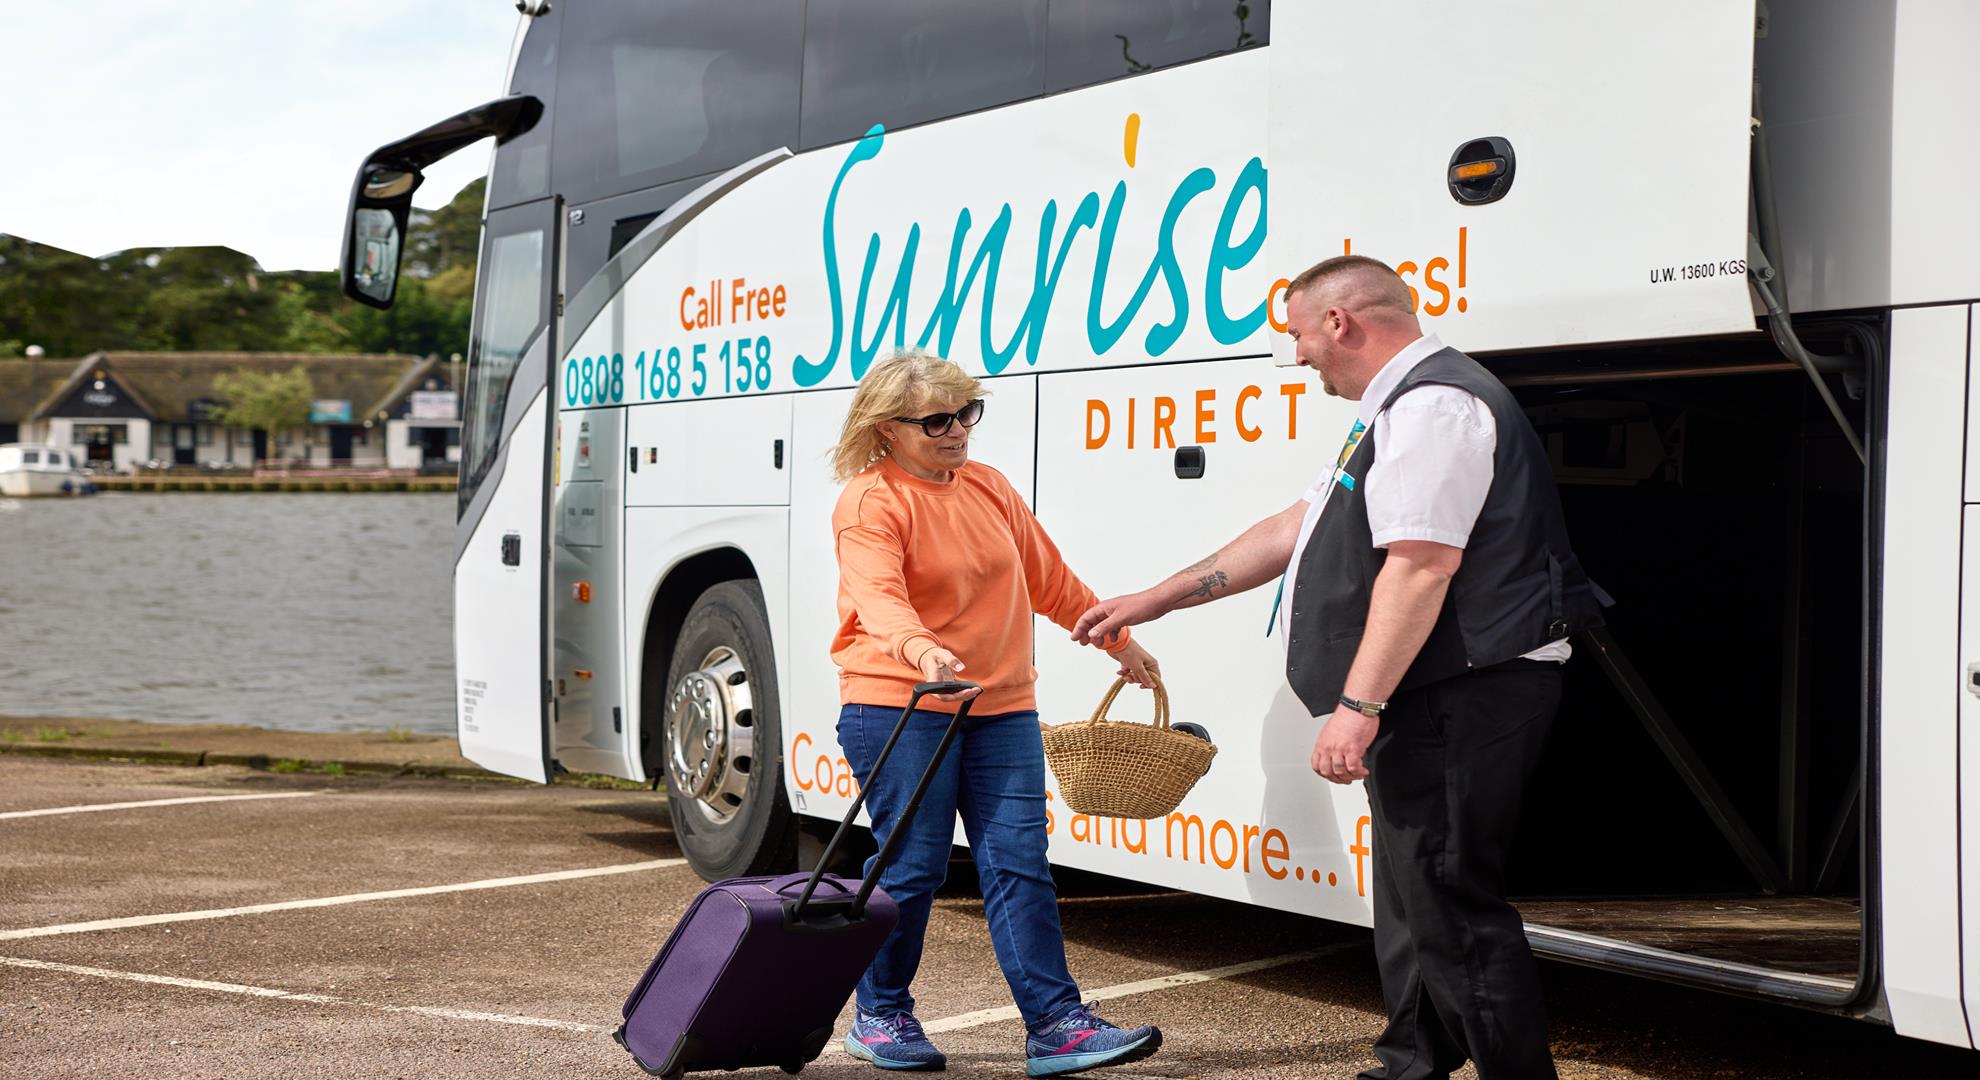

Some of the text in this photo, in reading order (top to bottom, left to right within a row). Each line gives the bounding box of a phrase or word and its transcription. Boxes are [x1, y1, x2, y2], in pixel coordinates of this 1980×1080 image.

[792, 112, 1268, 388] Sunrise
[1650, 259, 1746, 283] U.W. 13600 KGS
[680, 278, 787, 331] Call Free
[566, 335, 771, 406] 0808 168 5 158
[1085, 383, 1307, 450] DIRECT
[791, 732, 861, 798] Coa
[1166, 811, 1338, 887] more...
